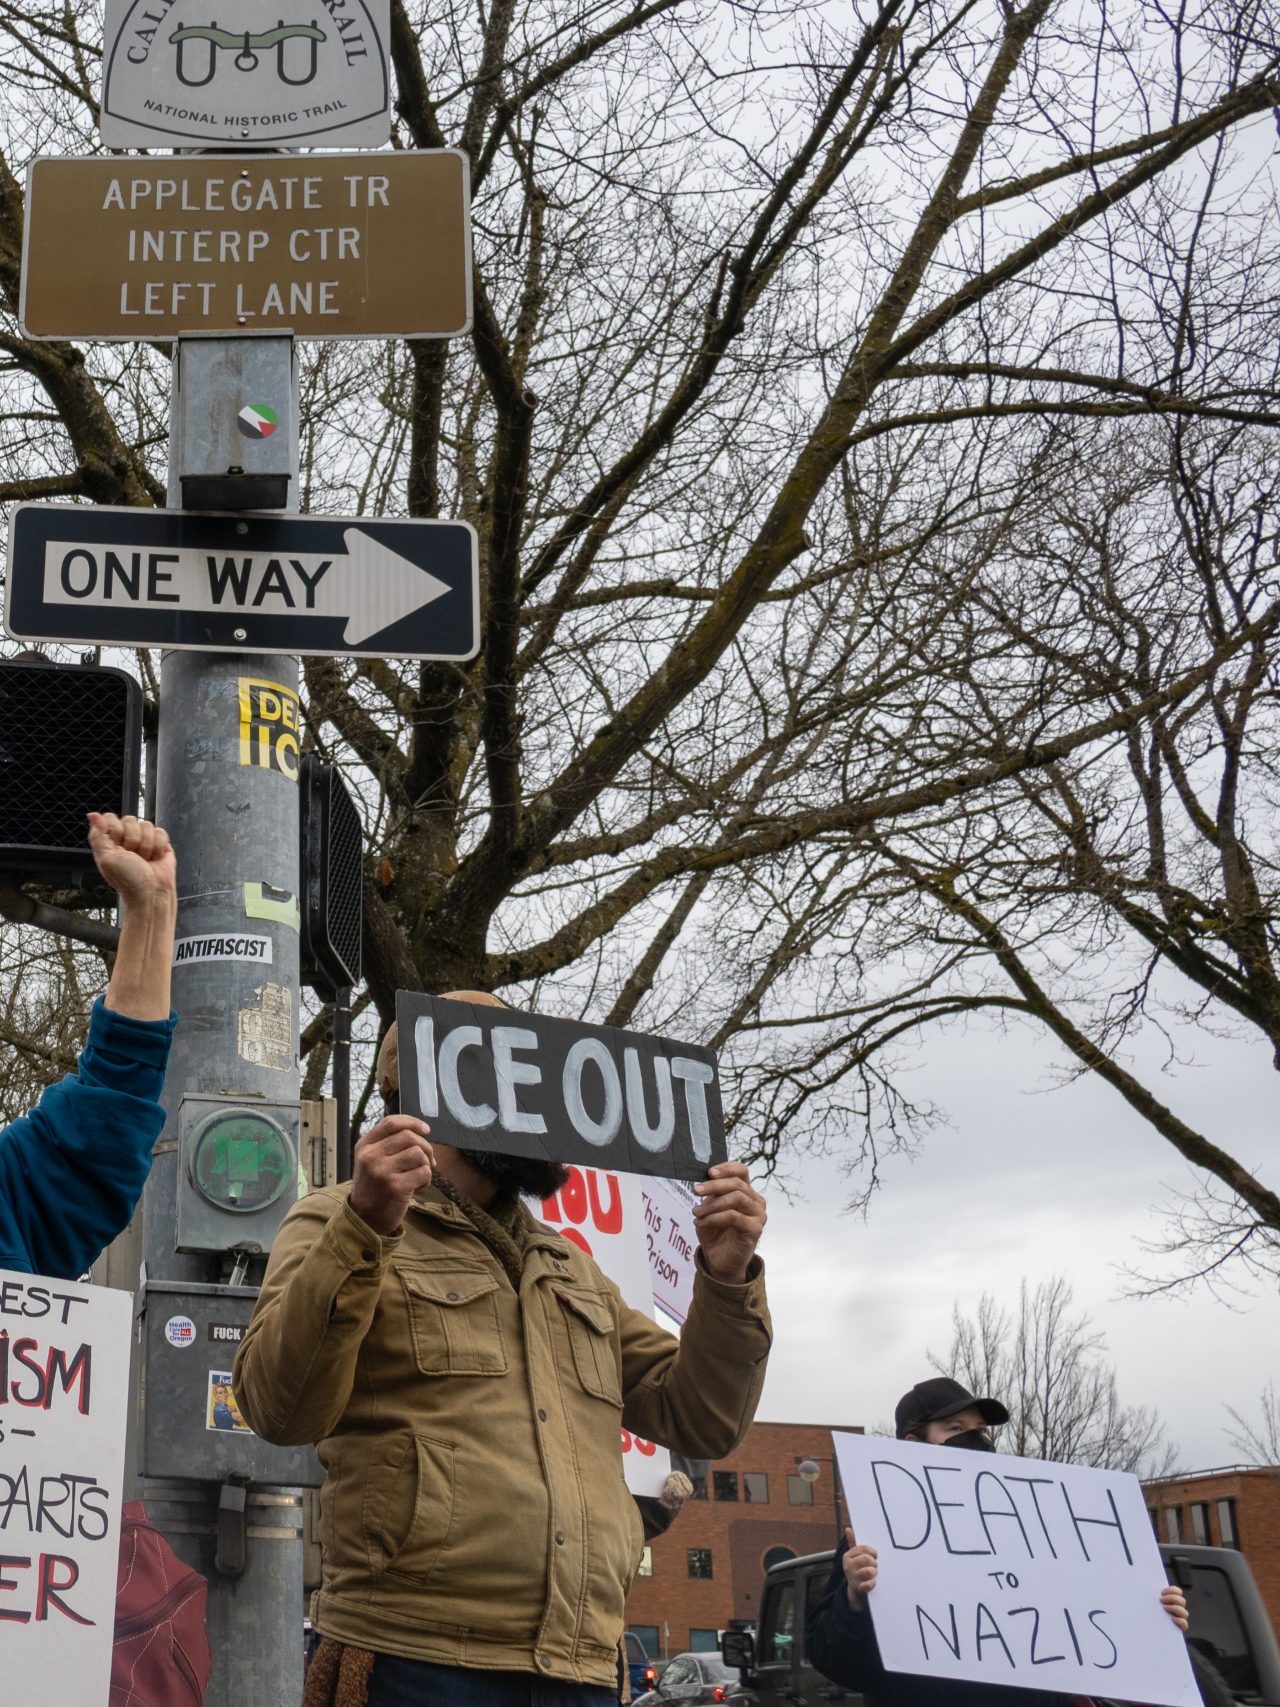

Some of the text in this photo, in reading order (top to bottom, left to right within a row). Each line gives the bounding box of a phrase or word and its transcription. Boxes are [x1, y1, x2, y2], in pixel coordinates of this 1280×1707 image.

[143, 99, 348, 126] NATIONAL HISTORIC TRAIL
[102, 176, 390, 211] APPLEGATE TR
[128, 228, 360, 263] INTERP CTR
[120, 282, 340, 316] LEFT LANE
[60, 549, 333, 608] ONE WAY
[259, 691, 300, 732] DE
[176, 938, 266, 960] ANTIFASCIST
[414, 1016, 548, 1134] ICE
[562, 1037, 714, 1163] OUT
[213, 1327, 241, 1340] FUCK
[871, 1461, 1134, 1566] DEATH
[915, 1602, 1118, 1669] NAZIS
